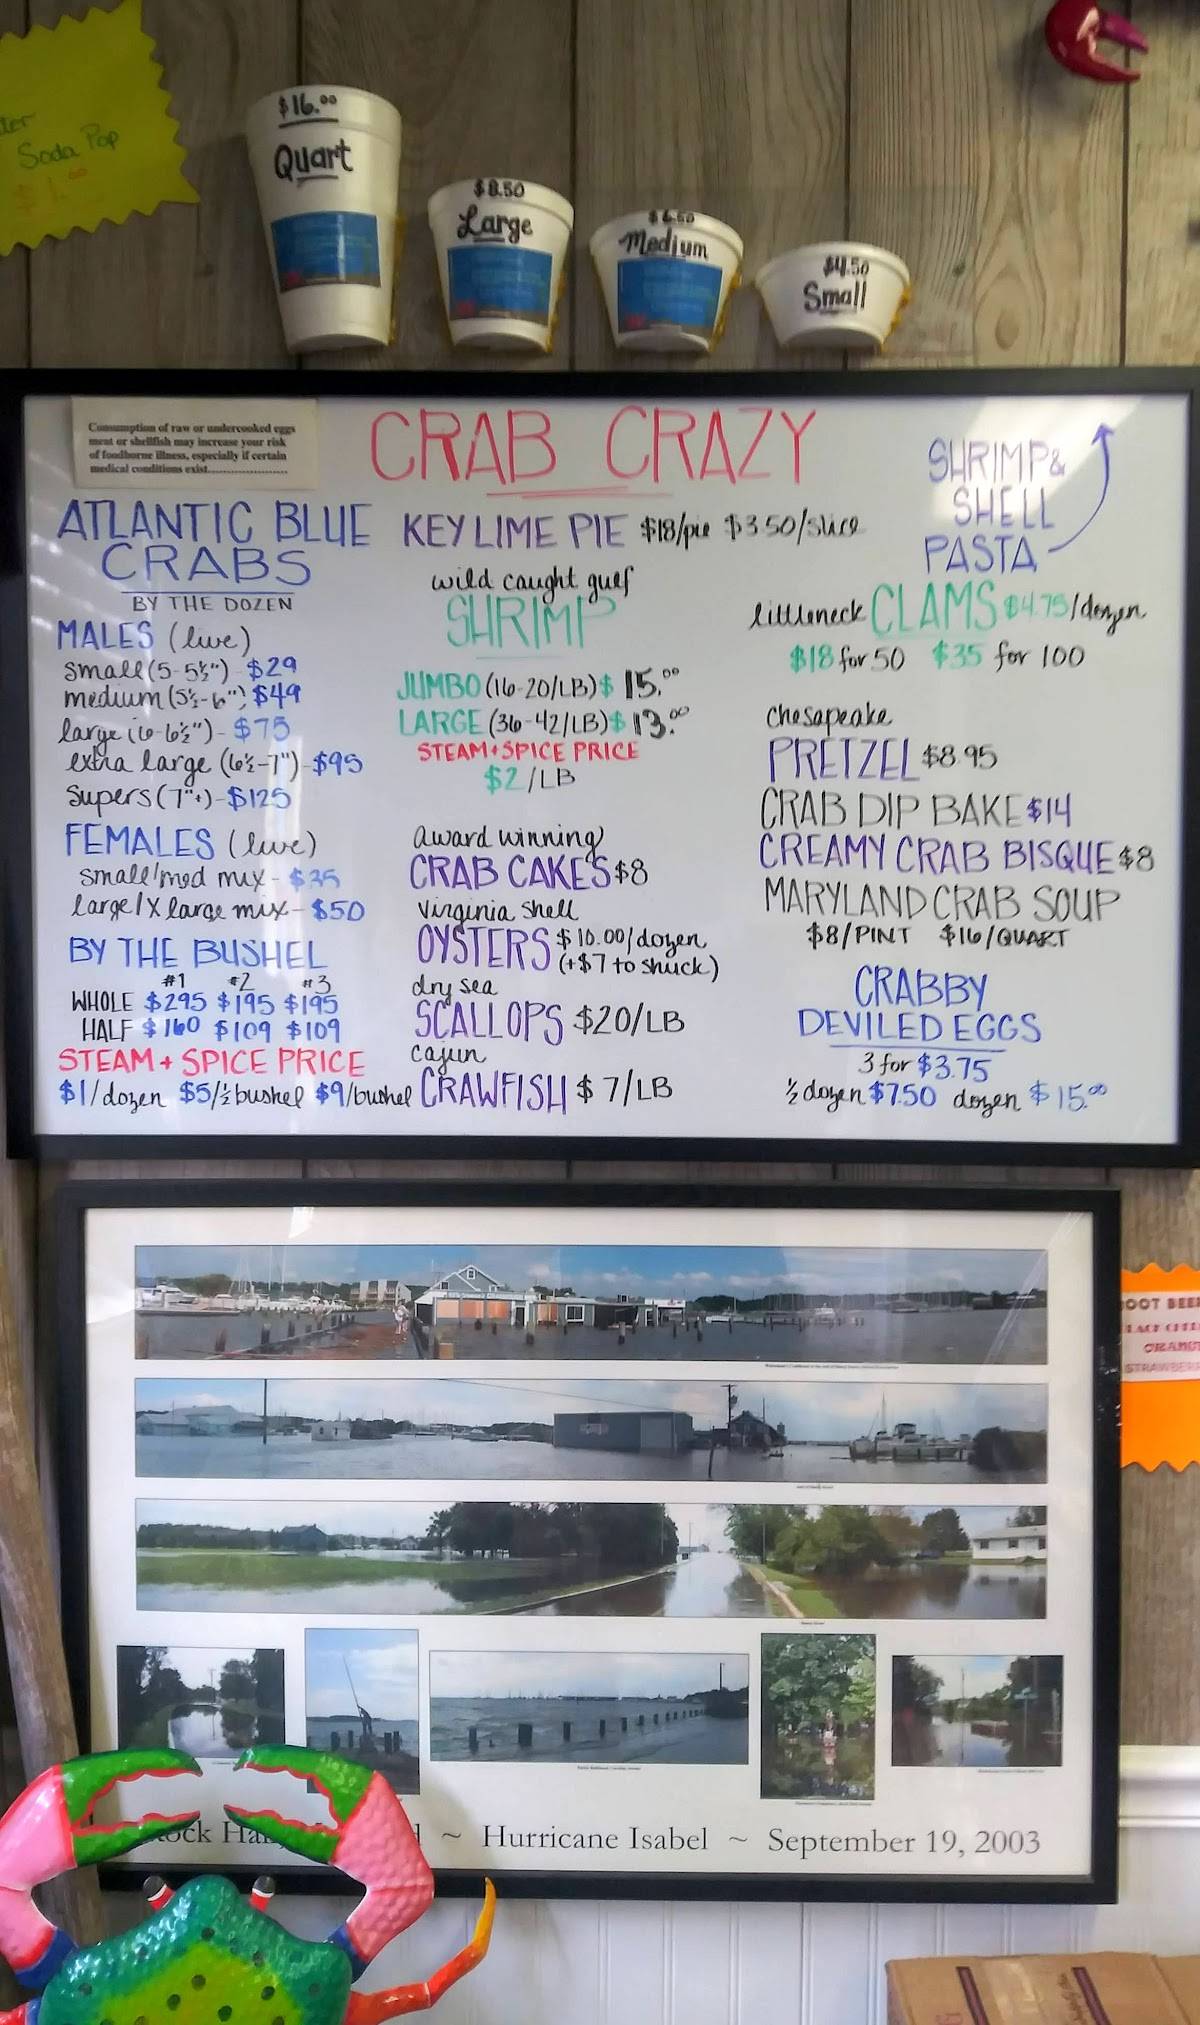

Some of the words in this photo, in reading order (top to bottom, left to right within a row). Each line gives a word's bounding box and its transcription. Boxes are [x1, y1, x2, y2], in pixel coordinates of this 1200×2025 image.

[18, 143, 80, 169] Soda
[80, 123, 118, 150] Pop
[275, 139, 353, 181] Quart
[457, 204, 533, 243] Large
[618, 227, 708, 260] Medium
[823, 255, 869, 277] $4.50
[803, 281, 867, 312] Small
[88, 422, 156, 435] Consumption
[158, 423, 169, 433] of
[171, 425, 190, 433] raw
[193, 425, 204, 433] or
[207, 424, 271, 433] undercooked
[274, 425, 295, 435] eggs
[130, 436, 171, 446] shellfish
[174, 439, 194, 448] may
[198, 438, 238, 447] increase
[241, 439, 263, 448] your
[267, 438, 286, 447] risk
[370, 408, 557, 485] CRAB
[606, 405, 817, 485] CRAZY
[89, 450, 99, 459] of
[102, 451, 153, 460] foodborne
[156, 451, 189, 460] illness,
[192, 451, 239, 462] especially
[242, 450, 250, 460] if
[252, 451, 287, 460] certain
[90, 464, 129, 473] medical
[132, 463, 182, 473] conditions
[57, 499, 252, 544] ATLANTIC
[276, 500, 372, 547] BLUE
[953, 486, 1055, 529] SHELL
[403, 512, 465, 548] KEY
[475, 513, 558, 549] LIME
[568, 512, 628, 549] PIE
[101, 542, 312, 585] CRABS
[924, 535, 1038, 575] PASTA
[431, 566, 495, 590] wild
[502, 566, 579, 604] caught
[132, 596, 157, 612] BY
[171, 596, 213, 611] THE
[224, 597, 292, 612] DOZEN
[871, 580, 997, 637] CLAMS
[57, 619, 154, 650] MALES
[446, 594, 617, 649] SHRIMP
[247, 656, 297, 681] $29
[790, 644, 834, 675] $18
[838, 646, 868, 673] for
[871, 645, 905, 671] 50
[993, 639, 1030, 677] for
[1041, 643, 1086, 672] 100
[253, 682, 301, 709] $49
[397, 670, 481, 700] JUMBO
[234, 716, 290, 742] $75
[399, 707, 485, 736] LARGE
[573, 742, 640, 762] PRICE
[769, 736, 920, 782] PRETZEL
[761, 787, 846, 830] CRAB
[859, 792, 920, 829] DIP
[933, 793, 1024, 828] BAKE
[1026, 792, 1072, 828] $14
[66, 823, 215, 861] FEMALES
[759, 832, 887, 871] CREAMY
[897, 836, 990, 875] CRAB
[1003, 839, 1116, 875] BISQUE
[1118, 846, 1155, 873] $8
[410, 854, 499, 890] CRAB
[508, 854, 611, 890] CAKES
[615, 859, 649, 885] $8
[312, 898, 365, 922] $50
[765, 876, 928, 920] MARYLAND
[933, 885, 1022, 921] CRAB
[1033, 884, 1121, 923] SOUP
[69, 936, 106, 967] BY
[117, 937, 178, 969] THE
[194, 938, 328, 970] BUSHEL
[417, 924, 551, 971] OYSTERS
[613, 956, 636, 973] to
[72, 991, 134, 1013] WHOLE
[144, 992, 207, 1013] $295
[217, 993, 274, 1016] $195
[285, 994, 338, 1016] $195
[459, 978, 499, 996] sea
[855, 964, 988, 1011] CRABBY
[82, 1017, 134, 1043] HALF
[215, 1019, 271, 1043] $109
[287, 1020, 341, 1043] $109
[415, 1000, 564, 1046] SCALLOPS
[798, 1008, 943, 1041] DEVILED
[955, 1013, 1043, 1043] EGGS
[59, 1048, 154, 1074] STEAM
[181, 1049, 267, 1077] SPICE
[279, 1049, 366, 1077] PRICE
[859, 1051, 874, 1074] 3
[878, 1053, 911, 1082] for
[420, 1066, 567, 1115] CRAWFISH
[953, 1088, 1022, 1118] dozen
[1121, 1299, 1160, 1310] OOT
[151, 1820, 212, 1843] ock
[482, 1825, 617, 1848] Hurricane
[629, 1827, 707, 1851] Isabel
[768, 1827, 915, 1859] September
[927, 1830, 964, 1859] 19,
[974, 1830, 1041, 1855] 2003
